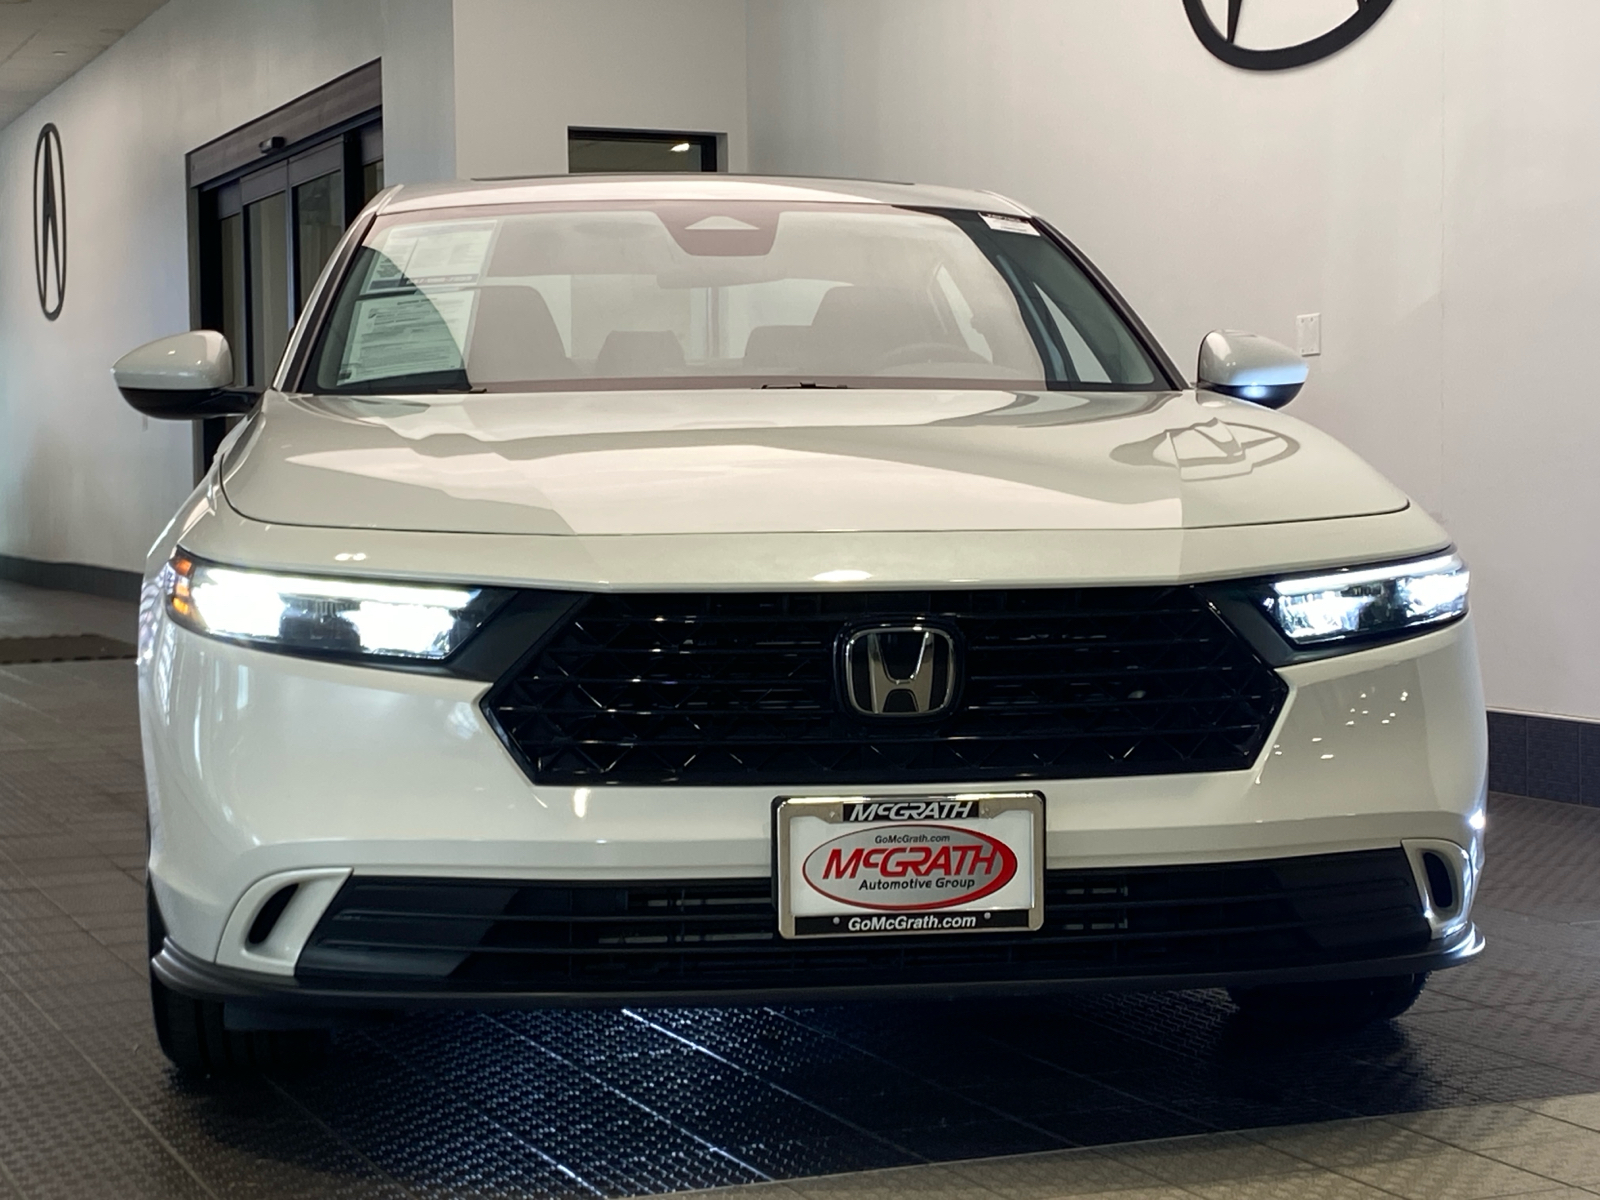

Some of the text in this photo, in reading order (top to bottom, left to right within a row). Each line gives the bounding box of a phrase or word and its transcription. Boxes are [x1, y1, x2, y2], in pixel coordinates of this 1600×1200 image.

[874, 834, 950, 844] GoMcGrath.com
[858, 877, 975, 891] Automotive Group
[848, 915, 976, 932] GoMcGrath.com
